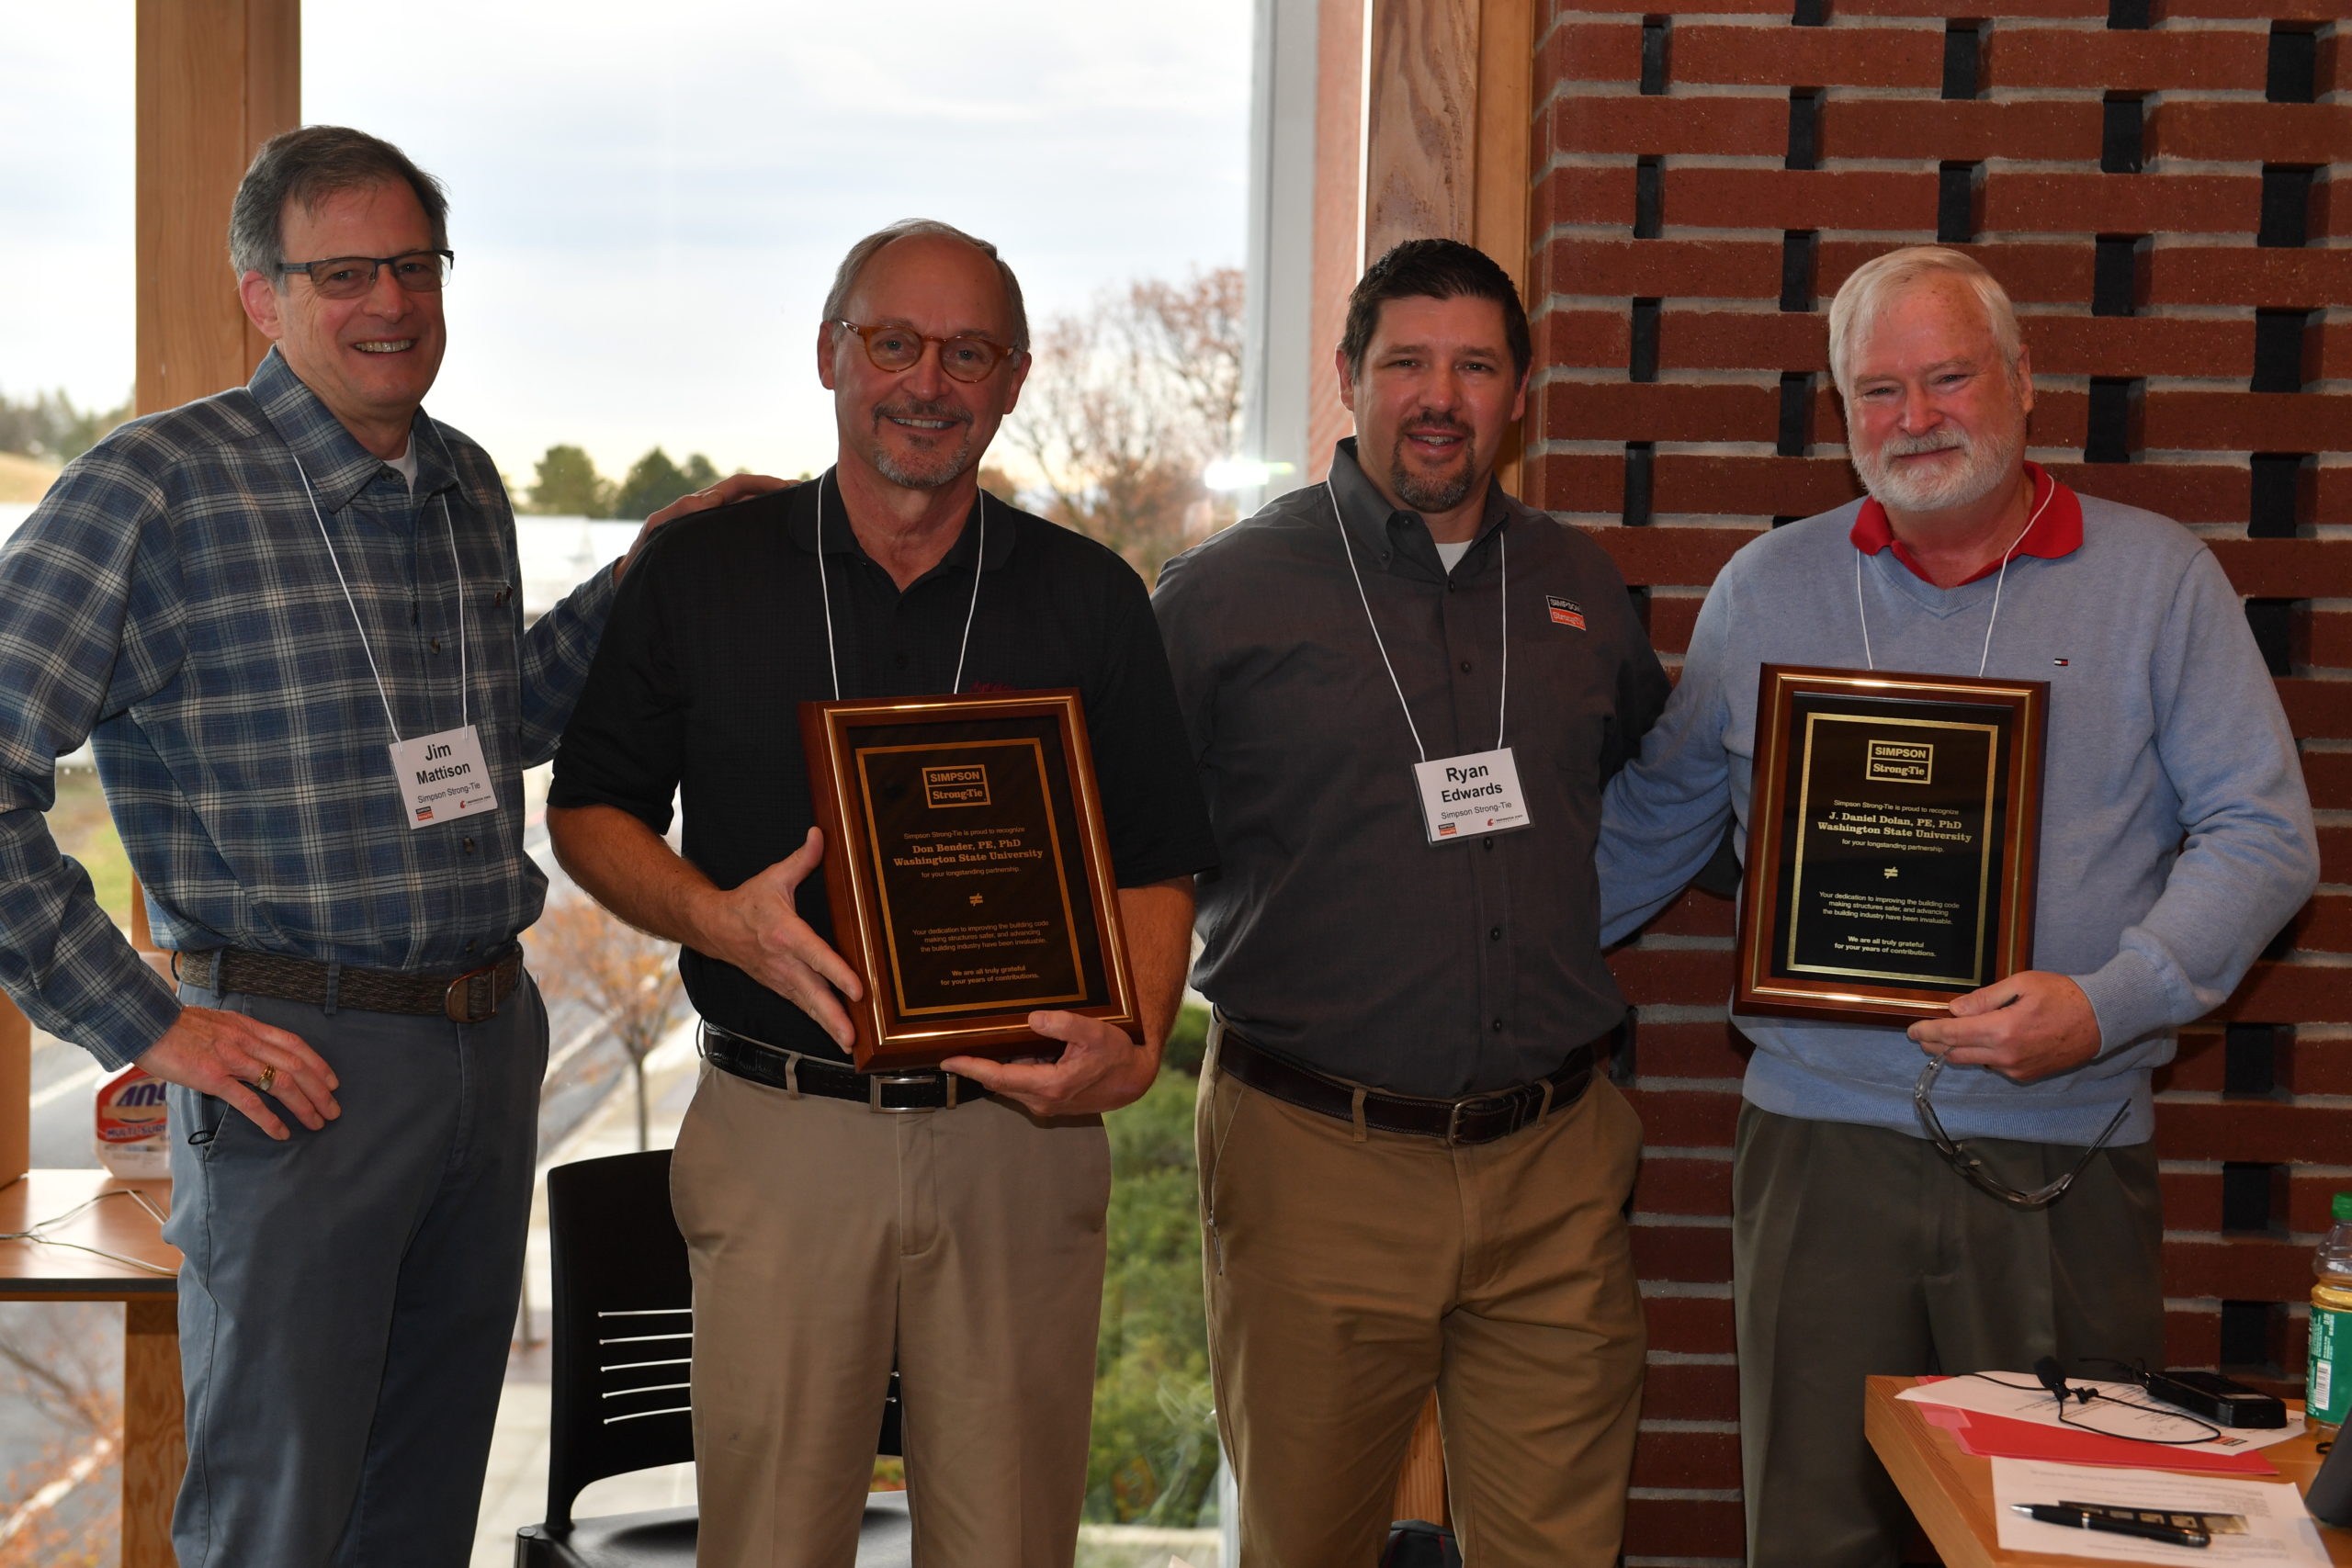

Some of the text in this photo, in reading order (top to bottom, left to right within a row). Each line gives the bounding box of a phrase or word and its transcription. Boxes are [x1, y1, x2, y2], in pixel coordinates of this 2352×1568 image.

[425, 744, 452, 761] Jim
[1875, 747, 1926, 758] SIMPSON
[416, 763, 470, 784] Mattison
[930, 771, 979, 782] SIMPSON
[1446, 765, 1489, 784] Ryan
[1872, 763, 1925, 776] Strong-Tie
[418, 783, 481, 804] Simpson Strong-Tie
[933, 788, 983, 800] Strong-Tie
[1442, 783, 1503, 803] Edwards
[1442, 801, 1512, 819] Simpson Strong-Tie
[1833, 799, 1860, 807] Simpson
[1861, 801, 1894, 810] Strong-Tie
[1828, 811, 1962, 829] J. Daniel Dolan, PE, PhD
[1817, 821, 1972, 843] Washington State University
[912, 839, 1021, 853] Don Bender, PE, PhD
[1867, 840, 1906, 851] longstanding
[893, 850, 1043, 866] Washington State University
[945, 868, 985, 877] longstanding
[1852, 902, 1883, 910] structures
[1917, 908, 1949, 917] advancing
[1875, 897, 1905, 905] improving
[1917, 899, 1943, 908] building
[1834, 909, 1859, 918] building
[1860, 911, 1884, 919] industry
[1001, 964, 1025, 974] grateful
